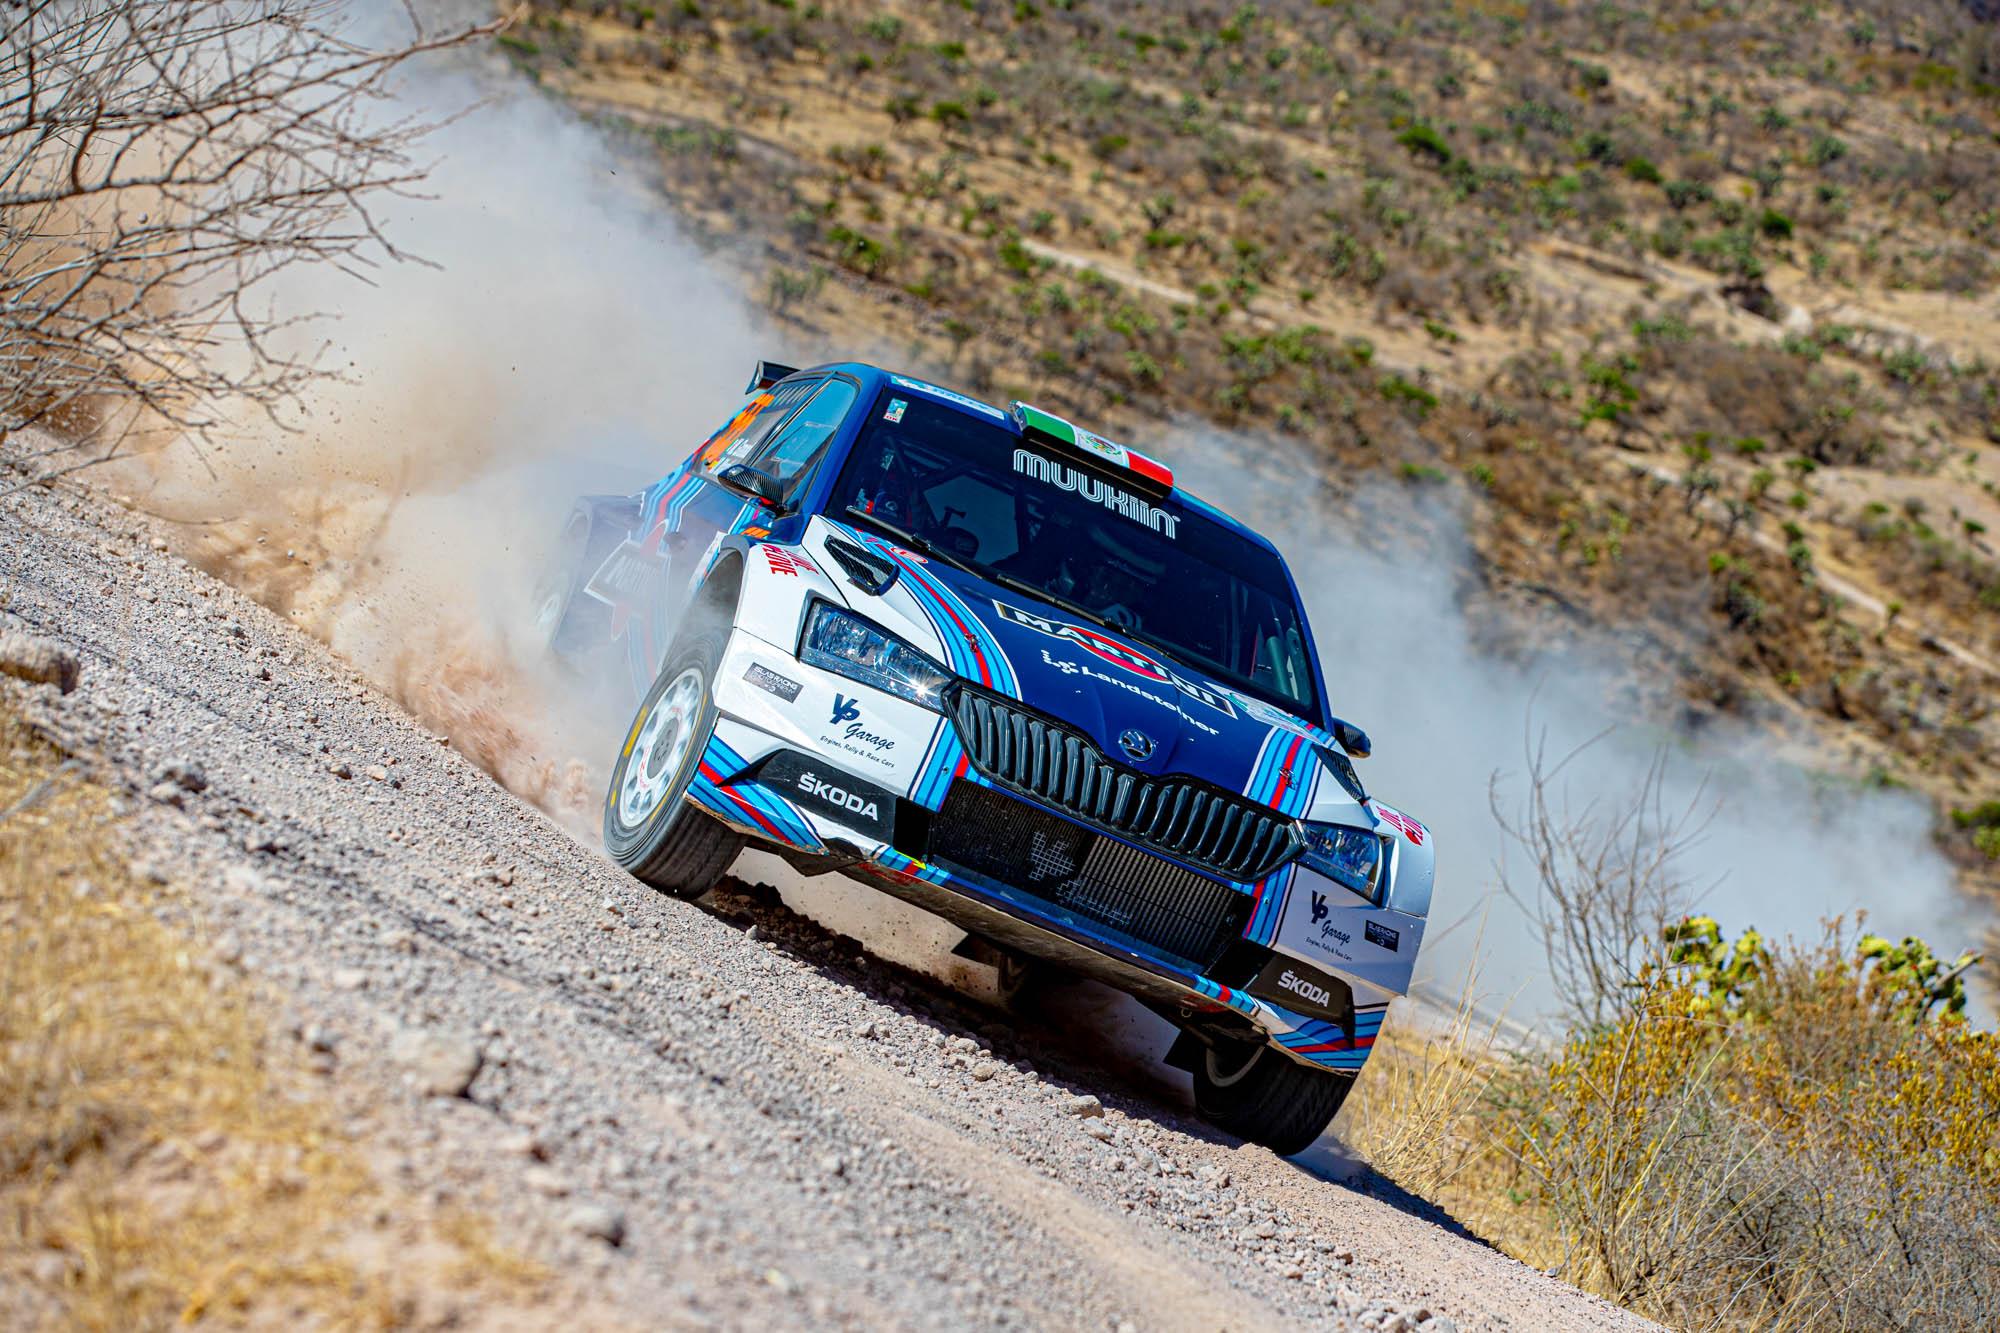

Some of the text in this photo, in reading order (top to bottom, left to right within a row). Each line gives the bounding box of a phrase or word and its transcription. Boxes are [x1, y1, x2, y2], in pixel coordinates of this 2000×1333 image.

[1013, 609, 1217, 705] MARTINI
[844, 722, 896, 751] Garage
[881, 759, 895, 768] Cars
[798, 772, 879, 822] ŠKODA
[1321, 919, 1351, 946] Garage
[1277, 969, 1332, 1008] ŠKODA
